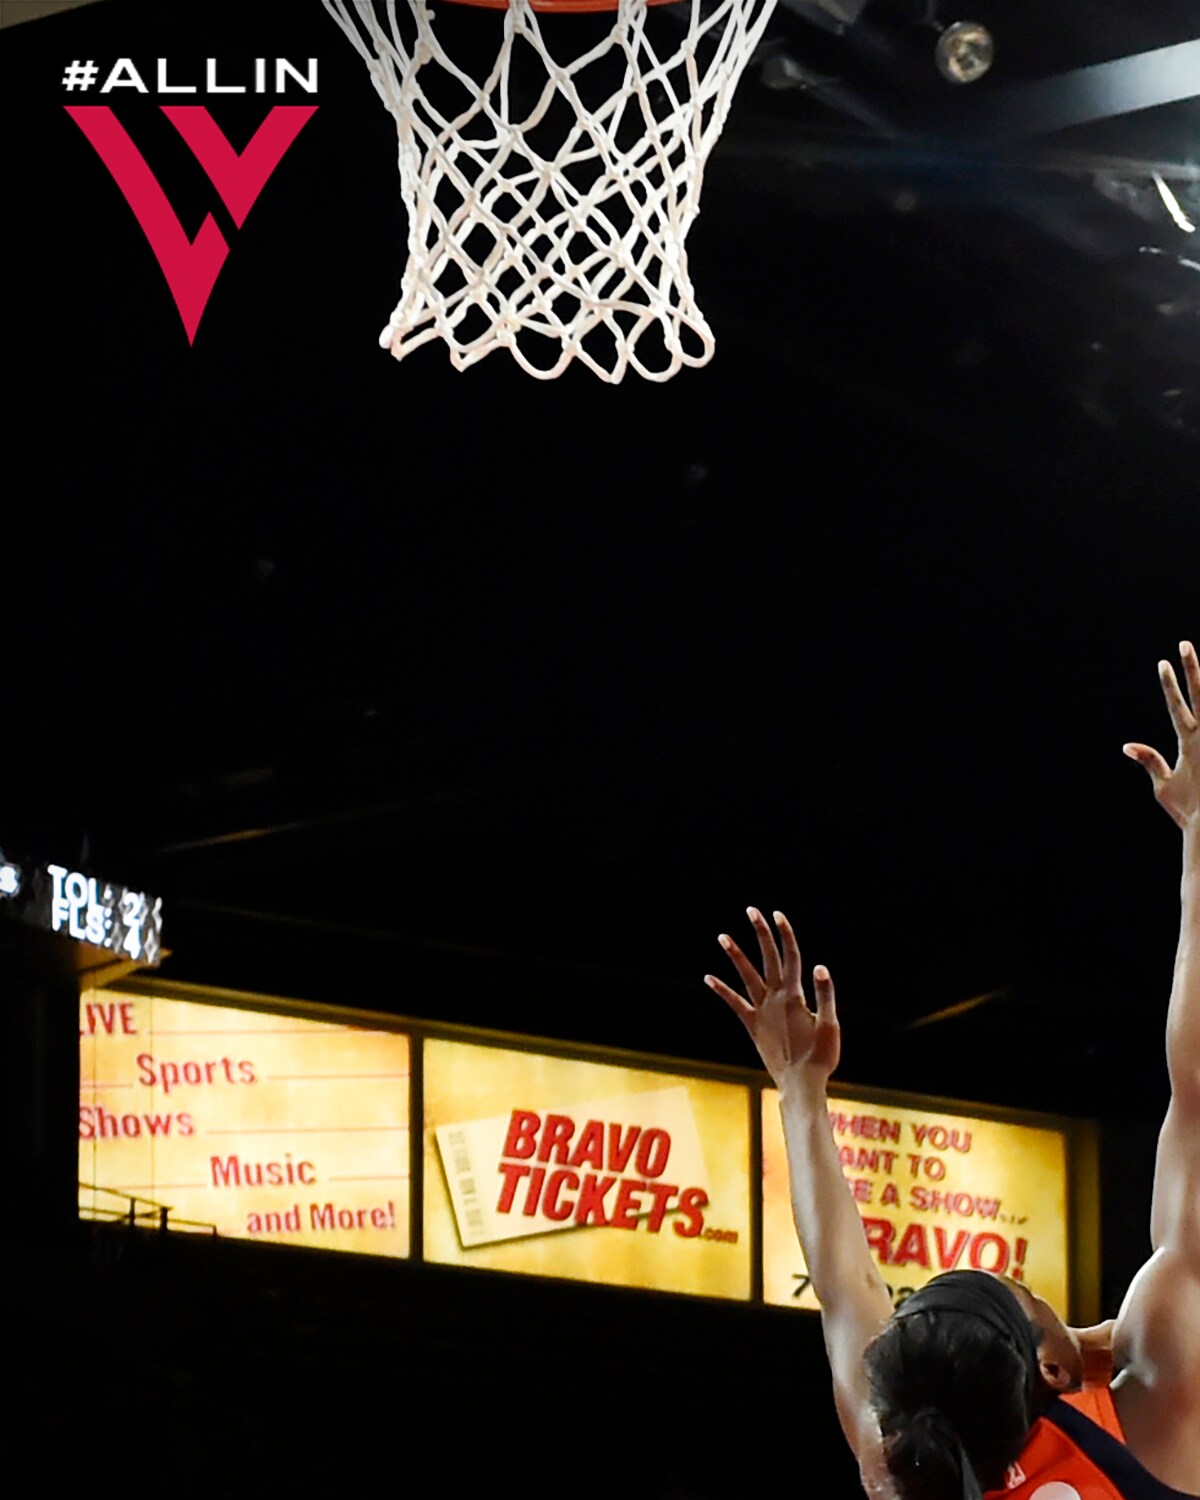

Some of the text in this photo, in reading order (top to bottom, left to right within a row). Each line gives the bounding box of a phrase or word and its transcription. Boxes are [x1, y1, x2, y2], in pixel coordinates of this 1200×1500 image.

[80, 1002, 137, 1035] IVE
[136, 1053, 258, 1094] Sports
[79, 1105, 196, 1140] Shows
[911, 1123, 973, 1153] YOU
[502, 1108, 672, 1179] BRAVO
[210, 1152, 318, 1188] Music
[838, 1145, 946, 1182] ANT TO
[880, 1182, 900, 1208] A
[246, 1200, 398, 1233] and More!
[861, 1216, 1028, 1281] RAVO!
